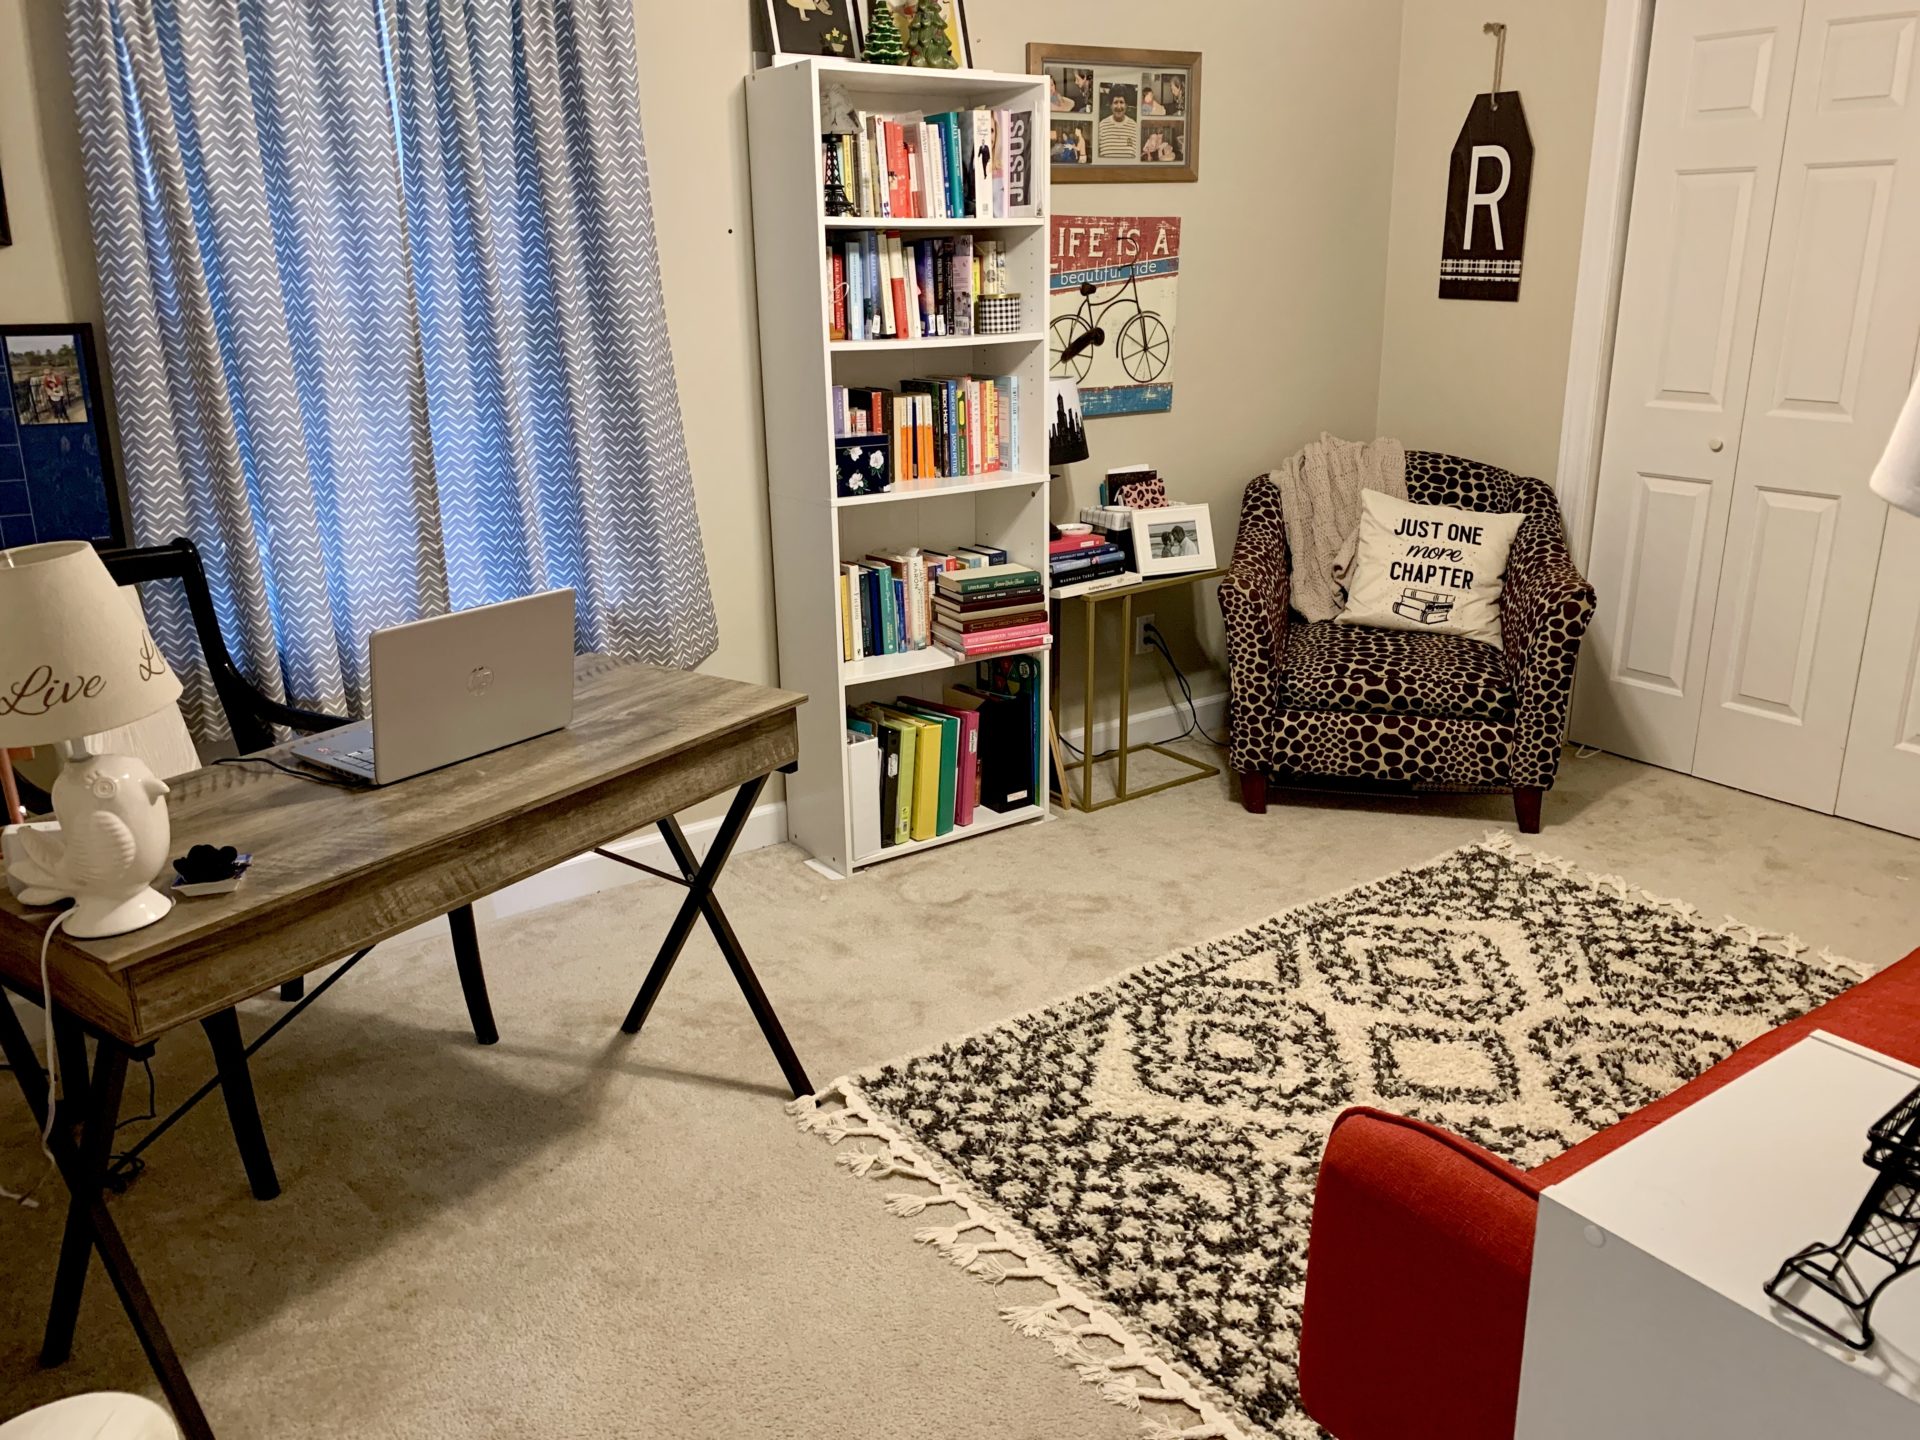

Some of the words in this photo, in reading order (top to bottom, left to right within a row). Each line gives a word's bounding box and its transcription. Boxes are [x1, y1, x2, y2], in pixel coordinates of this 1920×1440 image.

[1010, 120, 1025, 202] JESUS
[1462, 144, 1512, 251] R
[1052, 227, 1105, 262] IFE
[1116, 227, 1140, 256] IS
[1152, 227, 1170, 255] A
[1394, 518, 1444, 539] JUST
[1447, 523, 1484, 546] ONE
[1406, 545, 1463, 562] more
[1389, 561, 1475, 590] CHAPTER
[0, 664, 107, 716] Live
